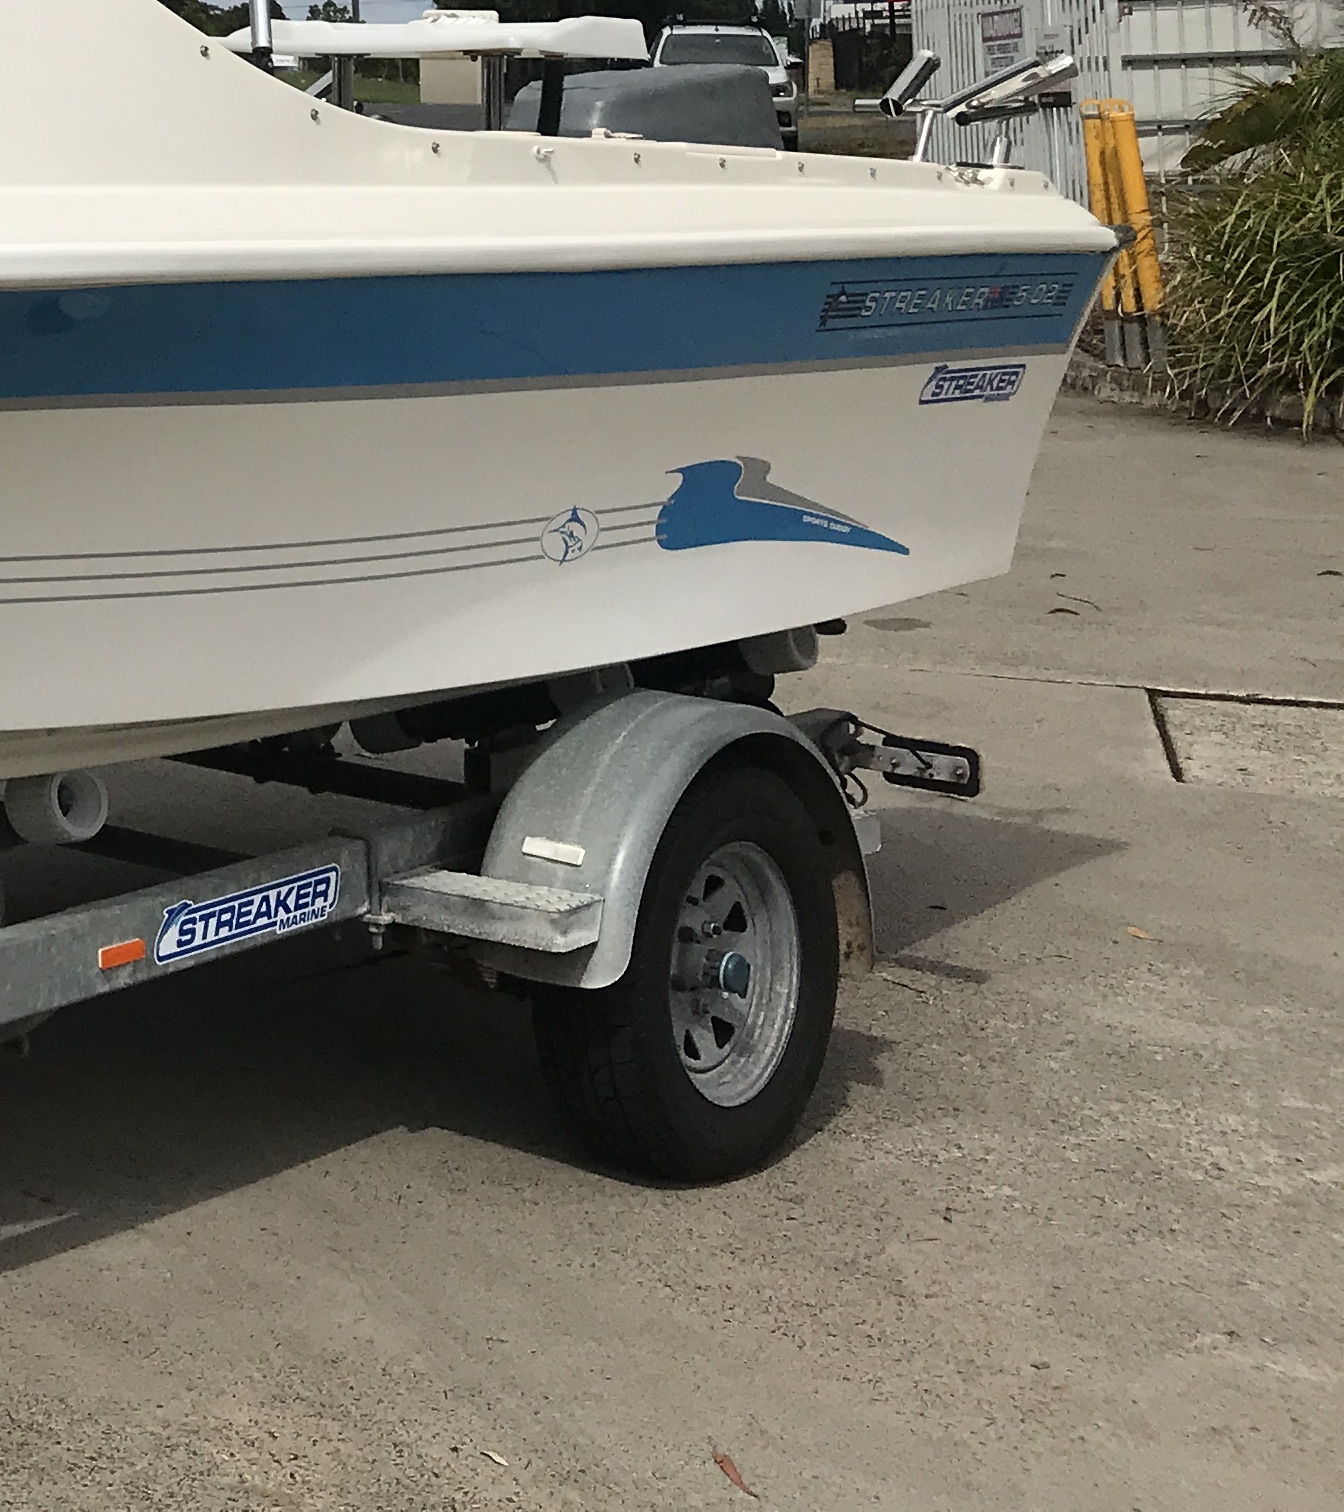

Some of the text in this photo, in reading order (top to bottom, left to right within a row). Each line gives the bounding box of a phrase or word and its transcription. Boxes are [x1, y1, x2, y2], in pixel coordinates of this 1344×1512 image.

[861, 287, 990, 317] STREAKER
[931, 371, 1021, 397] STREAKER
[176, 876, 332, 949] STREAKER
[278, 906, 328, 931] MARINE
